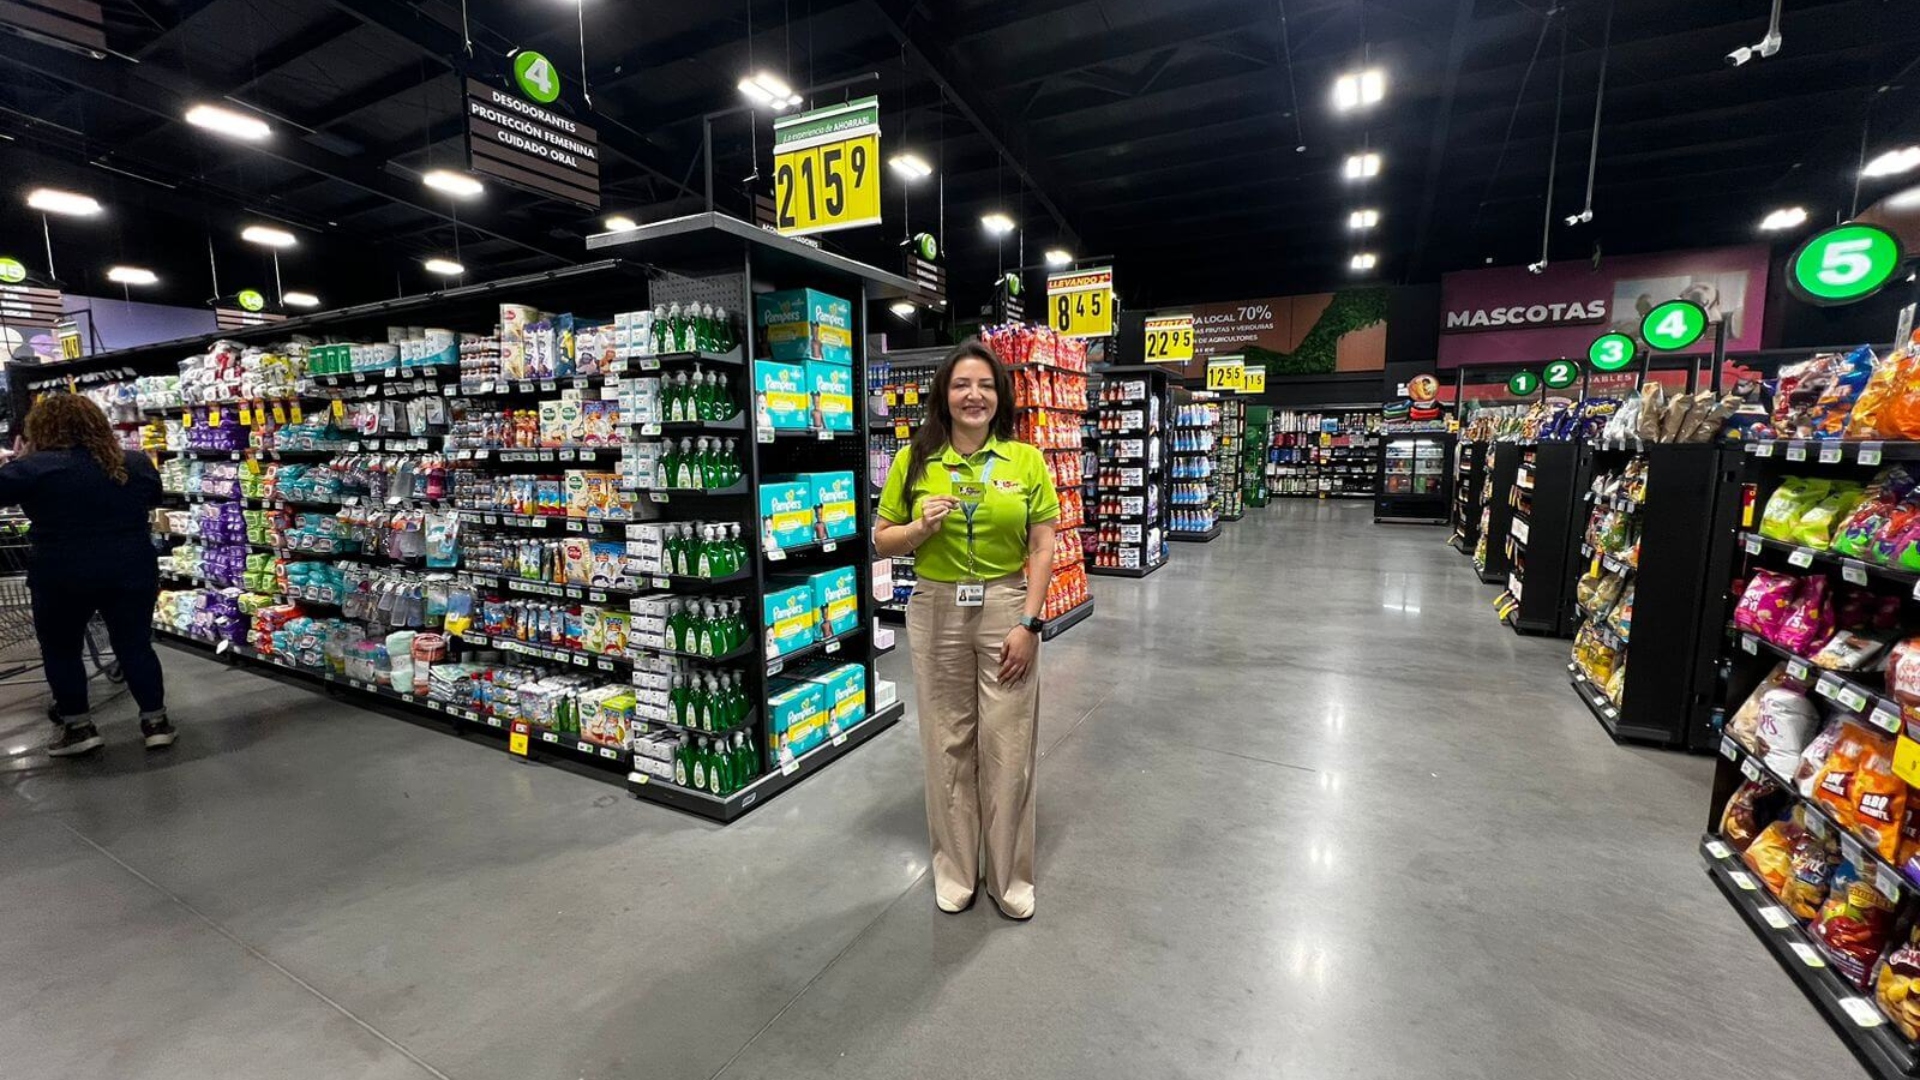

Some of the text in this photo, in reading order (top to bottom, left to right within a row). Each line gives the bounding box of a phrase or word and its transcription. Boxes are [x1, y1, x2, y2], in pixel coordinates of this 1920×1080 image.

[525, 58, 552, 93] 4
[492, 91, 576, 133] DESODORANTES
[471, 103, 595, 159] PROTECCIÓN FEMENINA
[497, 131, 577, 168] CUIDADO ORAL
[1816, 238, 1873, 285] 5
[1049, 276, 1098, 289] LLEVANDO
[764, 310, 800, 324] Pampers
[815, 305, 845, 327] Pampers
[1204, 313, 1236, 324] LOCAL
[1237, 304, 1272, 321] 70%
[1446, 299, 1606, 330] MASCOTAS
[1655, 310, 1688, 339] 4
[1205, 326, 1230, 334] FRUTAS
[1208, 334, 1259, 343] AGRICULTORES
[1600, 340, 1624, 363] 3
[1516, 376, 1526, 390] 1
[1549, 365, 1568, 382] 2
